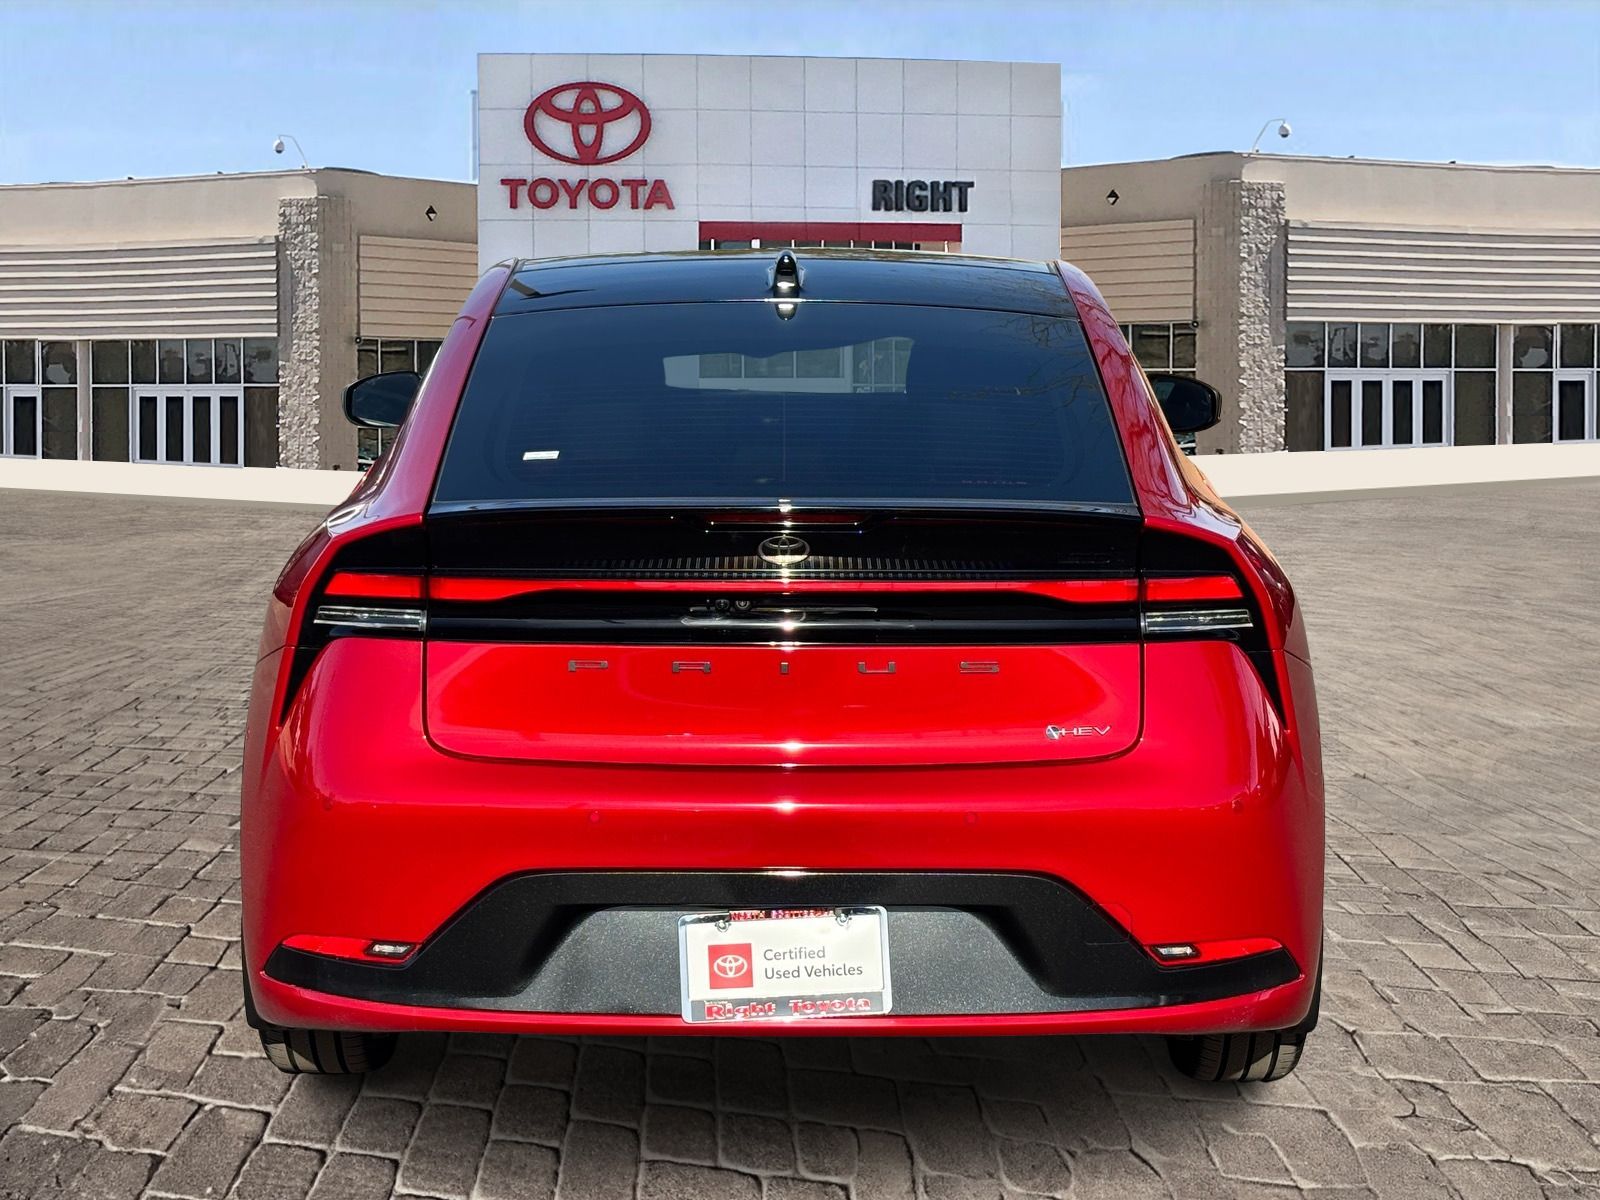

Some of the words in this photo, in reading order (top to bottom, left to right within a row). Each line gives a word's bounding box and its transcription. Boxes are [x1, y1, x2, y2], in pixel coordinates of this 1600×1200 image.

[500, 178, 675, 209] TOYOTA
[872, 179, 975, 212] RIGHT
[568, 659, 1000, 674] PRIUS
[1060, 725, 1111, 736] HEV
[763, 946, 826, 961] Certified
[764, 965, 801, 980] Used
[804, 962, 864, 978] Vehicles
[704, 1000, 776, 1020] Right
[789, 997, 871, 1016] Toyota
